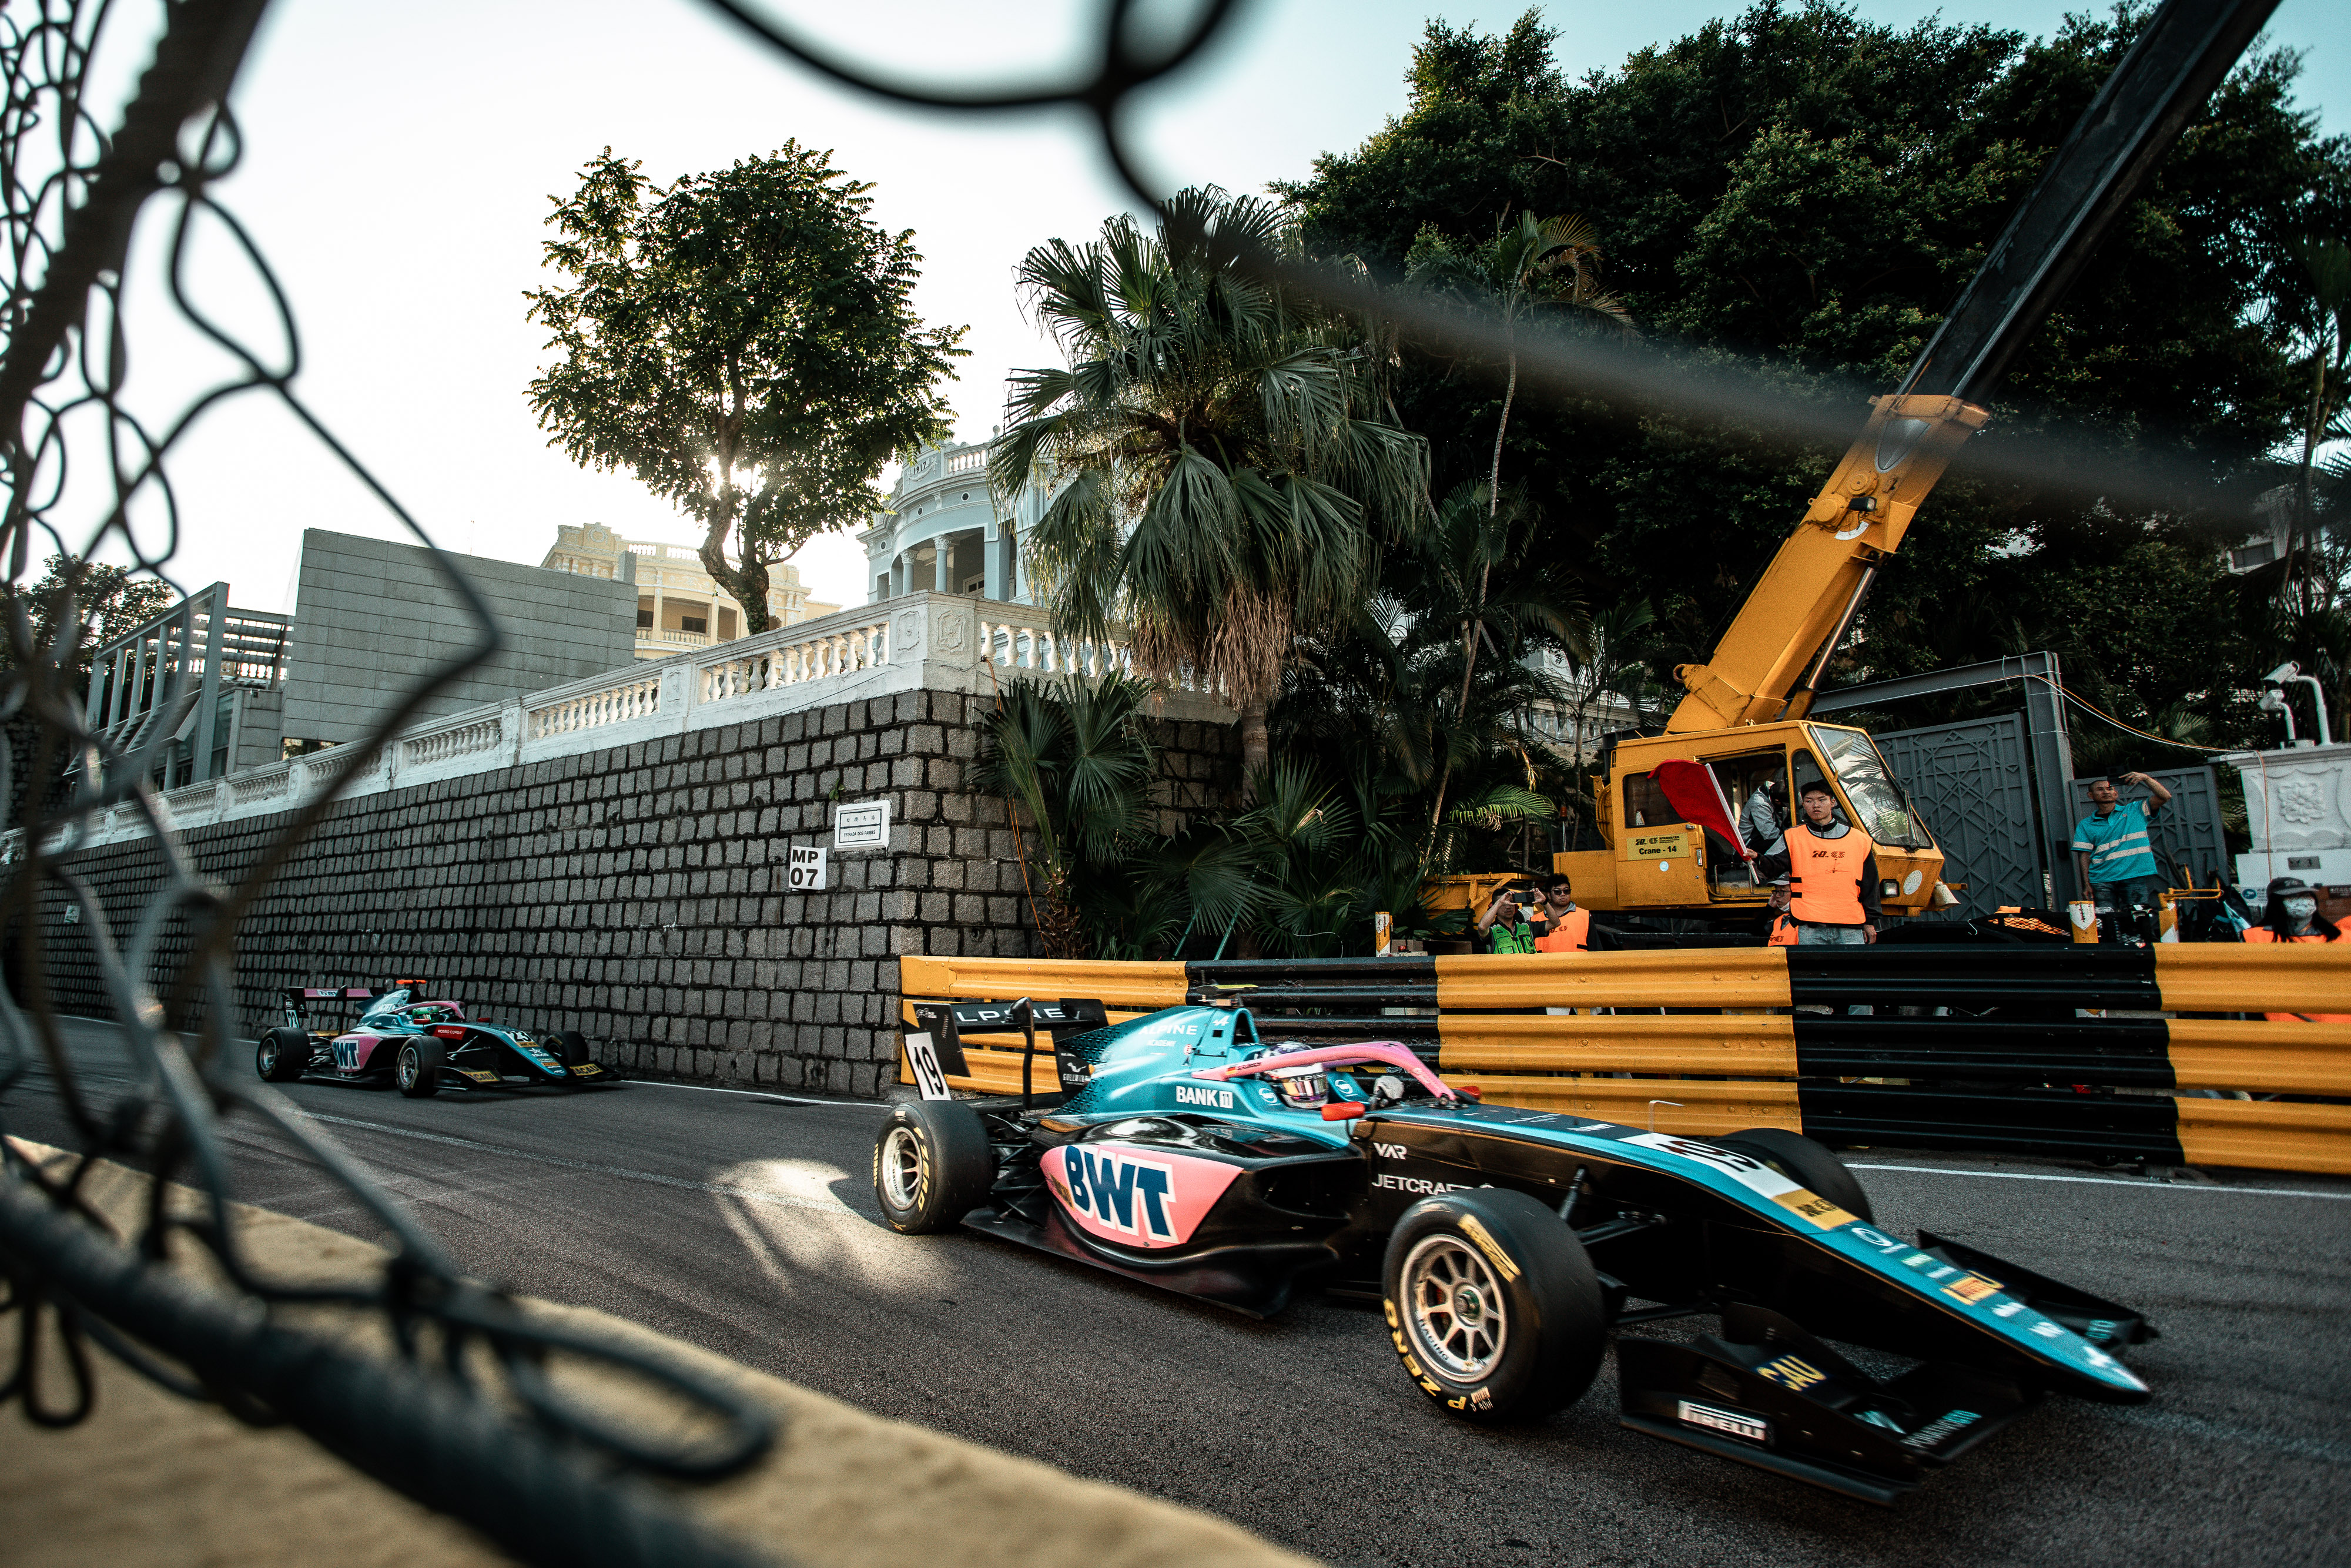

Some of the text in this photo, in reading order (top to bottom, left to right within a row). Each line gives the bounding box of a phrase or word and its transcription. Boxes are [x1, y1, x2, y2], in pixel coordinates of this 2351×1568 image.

[913, 461, 926, 475] 1917
[792, 849, 819, 864] MP
[790, 867, 818, 887] 07
[506, 1031, 532, 1042] 23
[1139, 1024, 1198, 1035] ALPINE
[913, 1046, 944, 1095] 19
[1177, 1085, 1219, 1107] BANK
[1373, 1142, 1408, 1160] VAR
[1655, 1140, 1763, 1173] 19
[1065, 1145, 1172, 1237] BWT
[1383, 1297, 1441, 1397] ZERO
[1418, 1318, 1449, 1361] RACING
[1677, 1399, 1767, 1440] PIRELLI
